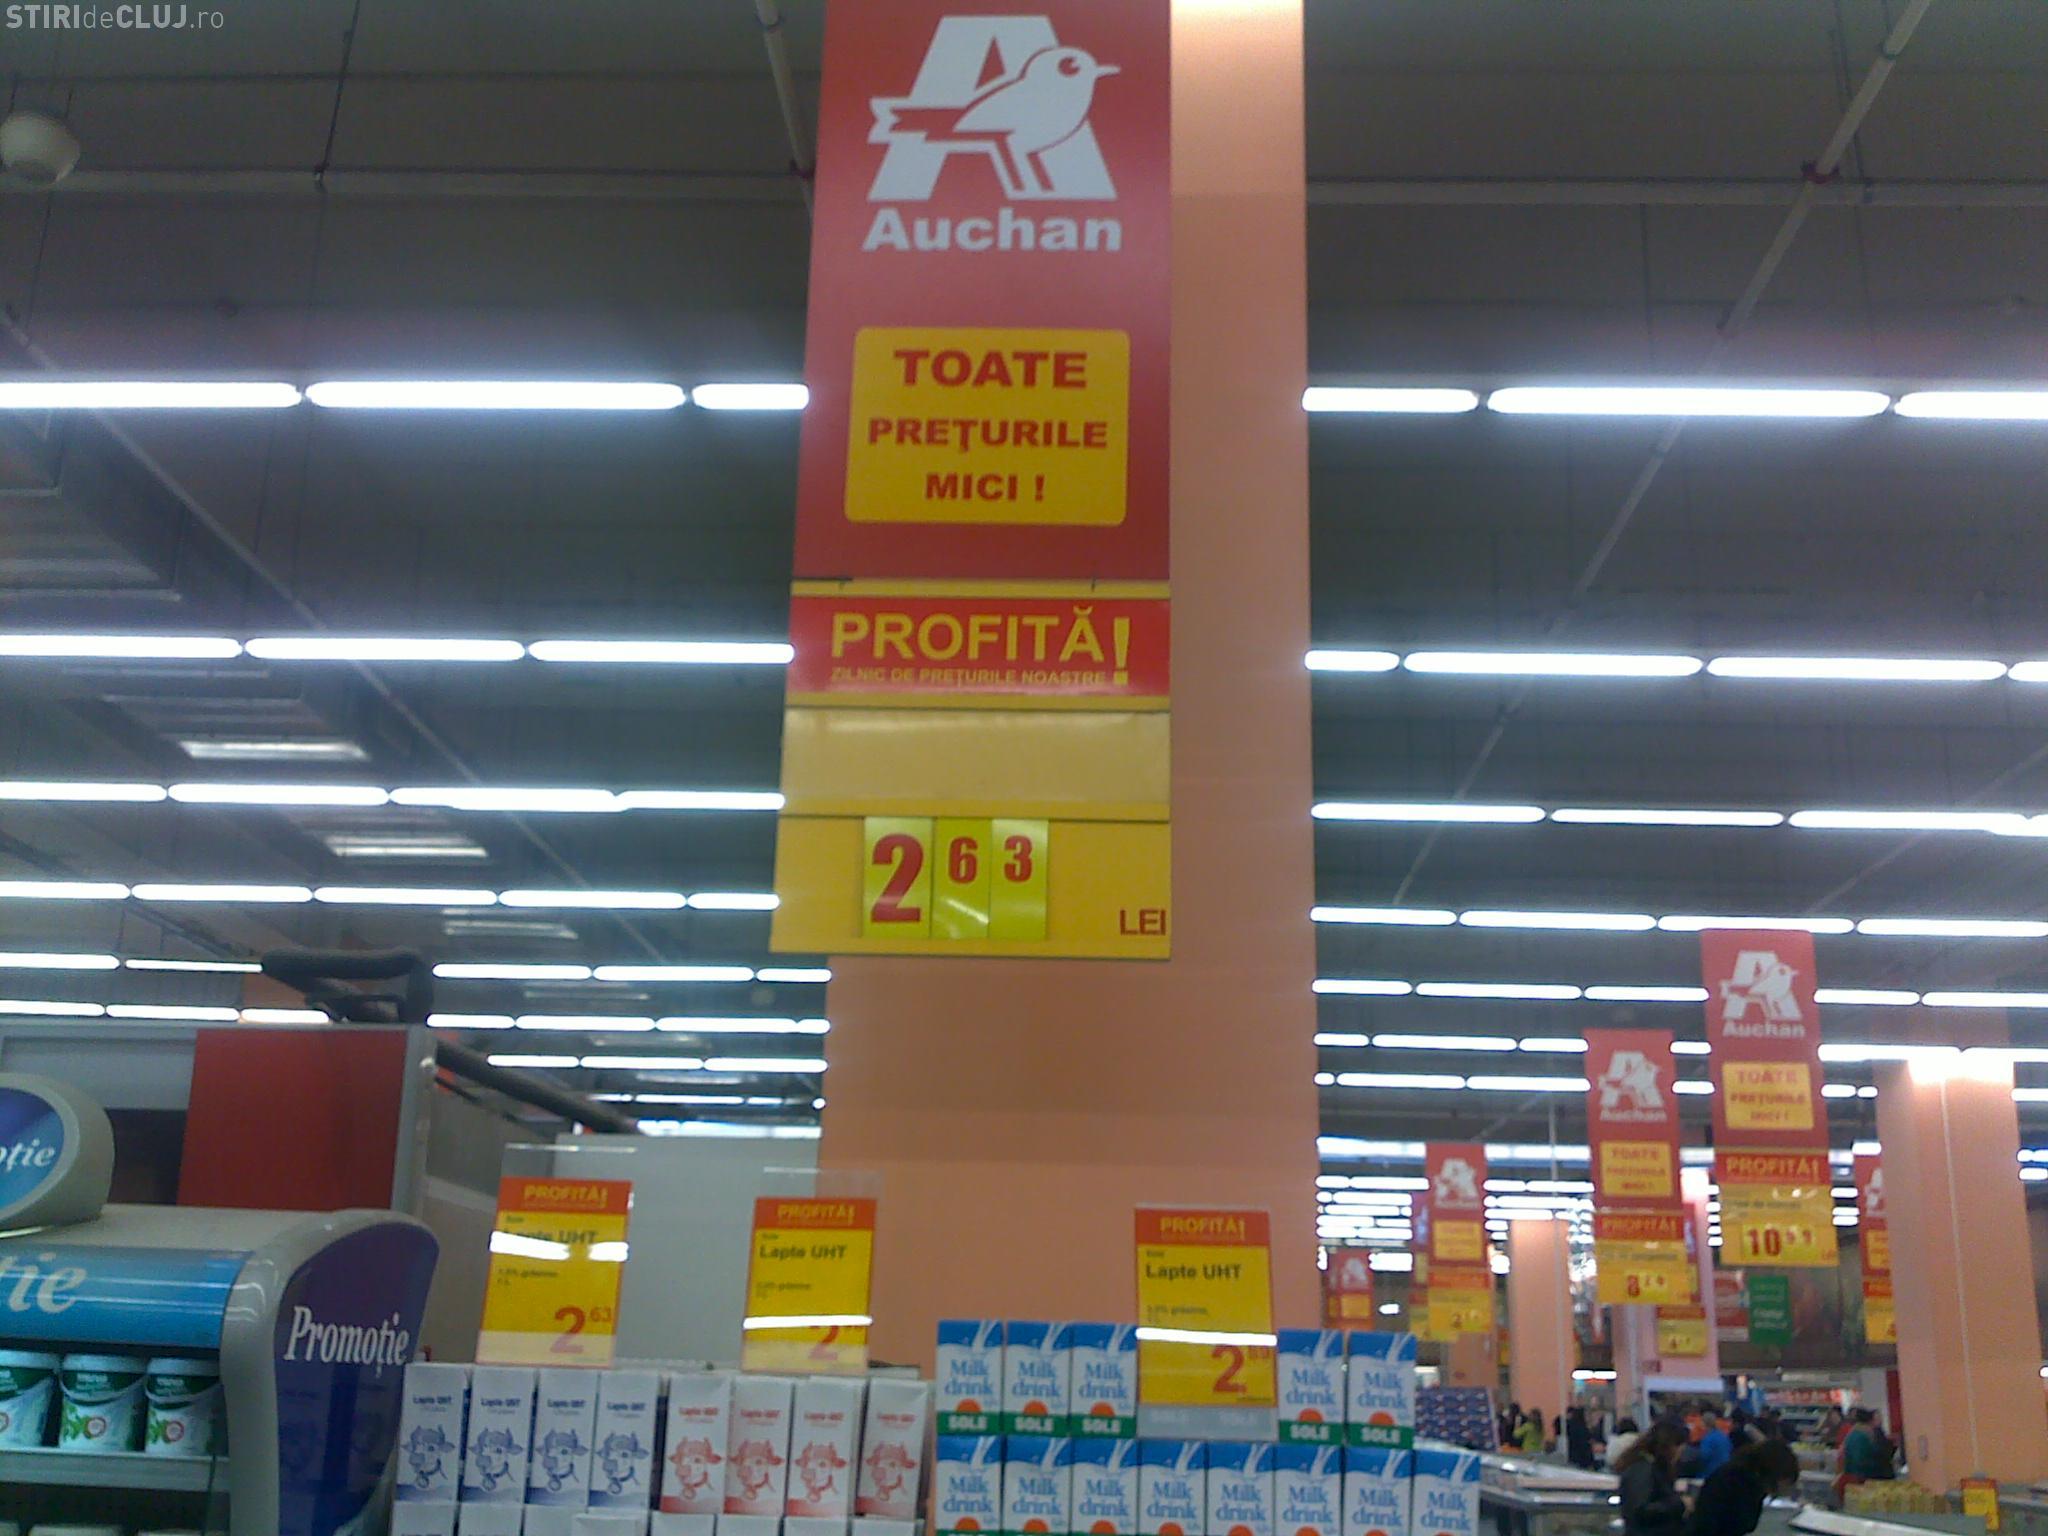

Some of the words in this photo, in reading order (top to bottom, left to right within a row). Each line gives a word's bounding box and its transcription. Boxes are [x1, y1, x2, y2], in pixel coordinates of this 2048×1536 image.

[862, 207, 1122, 252] Auchan
[894, 349, 1088, 389] TOATE
[925, 472, 1018, 501] MICI
[831, 605, 1130, 686] PROFITĂ!
[831, 666, 885, 682] ZILNIC
[891, 667, 913, 682] DE
[1021, 669, 1105, 686] NOASTRE
[1119, 908, 1167, 936] LEI
[1722, 1022, 1806, 1038] Auchan
[759, 1244, 806, 1261] Lapte
[810, 1243, 848, 1259] UHT
[1145, 1263, 1198, 1282] Lapte
[1202, 1263, 1242, 1280] UHT
[550, 1305, 586, 1354] 2
[951, 1358, 988, 1376] Milk
[1018, 1360, 1055, 1379] Milk
[1086, 1361, 1123, 1380] Milk
[1211, 1344, 1248, 1393] 2
[1292, 1368, 1330, 1386] Milk
[1364, 1370, 1402, 1389] Milk
[945, 1378, 993, 1396] drink
[1012, 1381, 1062, 1399] drink
[1079, 1382, 1129, 1400] drink
[1286, 1386, 1336, 1405] drink
[1357, 1389, 1408, 1409] drink
[950, 1475, 988, 1494] Milk
[1018, 1477, 1056, 1497] Milk
[1086, 1478, 1124, 1498] Milk
[1153, 1481, 1193, 1500] Milk
[1222, 1483, 1262, 1502] Milk
[1289, 1484, 1329, 1504] Milk
[943, 1496, 993, 1514] drink
[1012, 1499, 1062, 1516] drink
[1359, 1488, 1399, 1508] Milk
[1428, 1491, 1467, 1511] Milk
[1079, 1500, 1129, 1518] drink
[1146, 1501, 1197, 1520] drink
[1216, 1503, 1266, 1522] drink
[1283, 1505, 1333, 1524] drink
[1352, 1508, 1402, 1527] drink
[1420, 1511, 1472, 1531] drink
